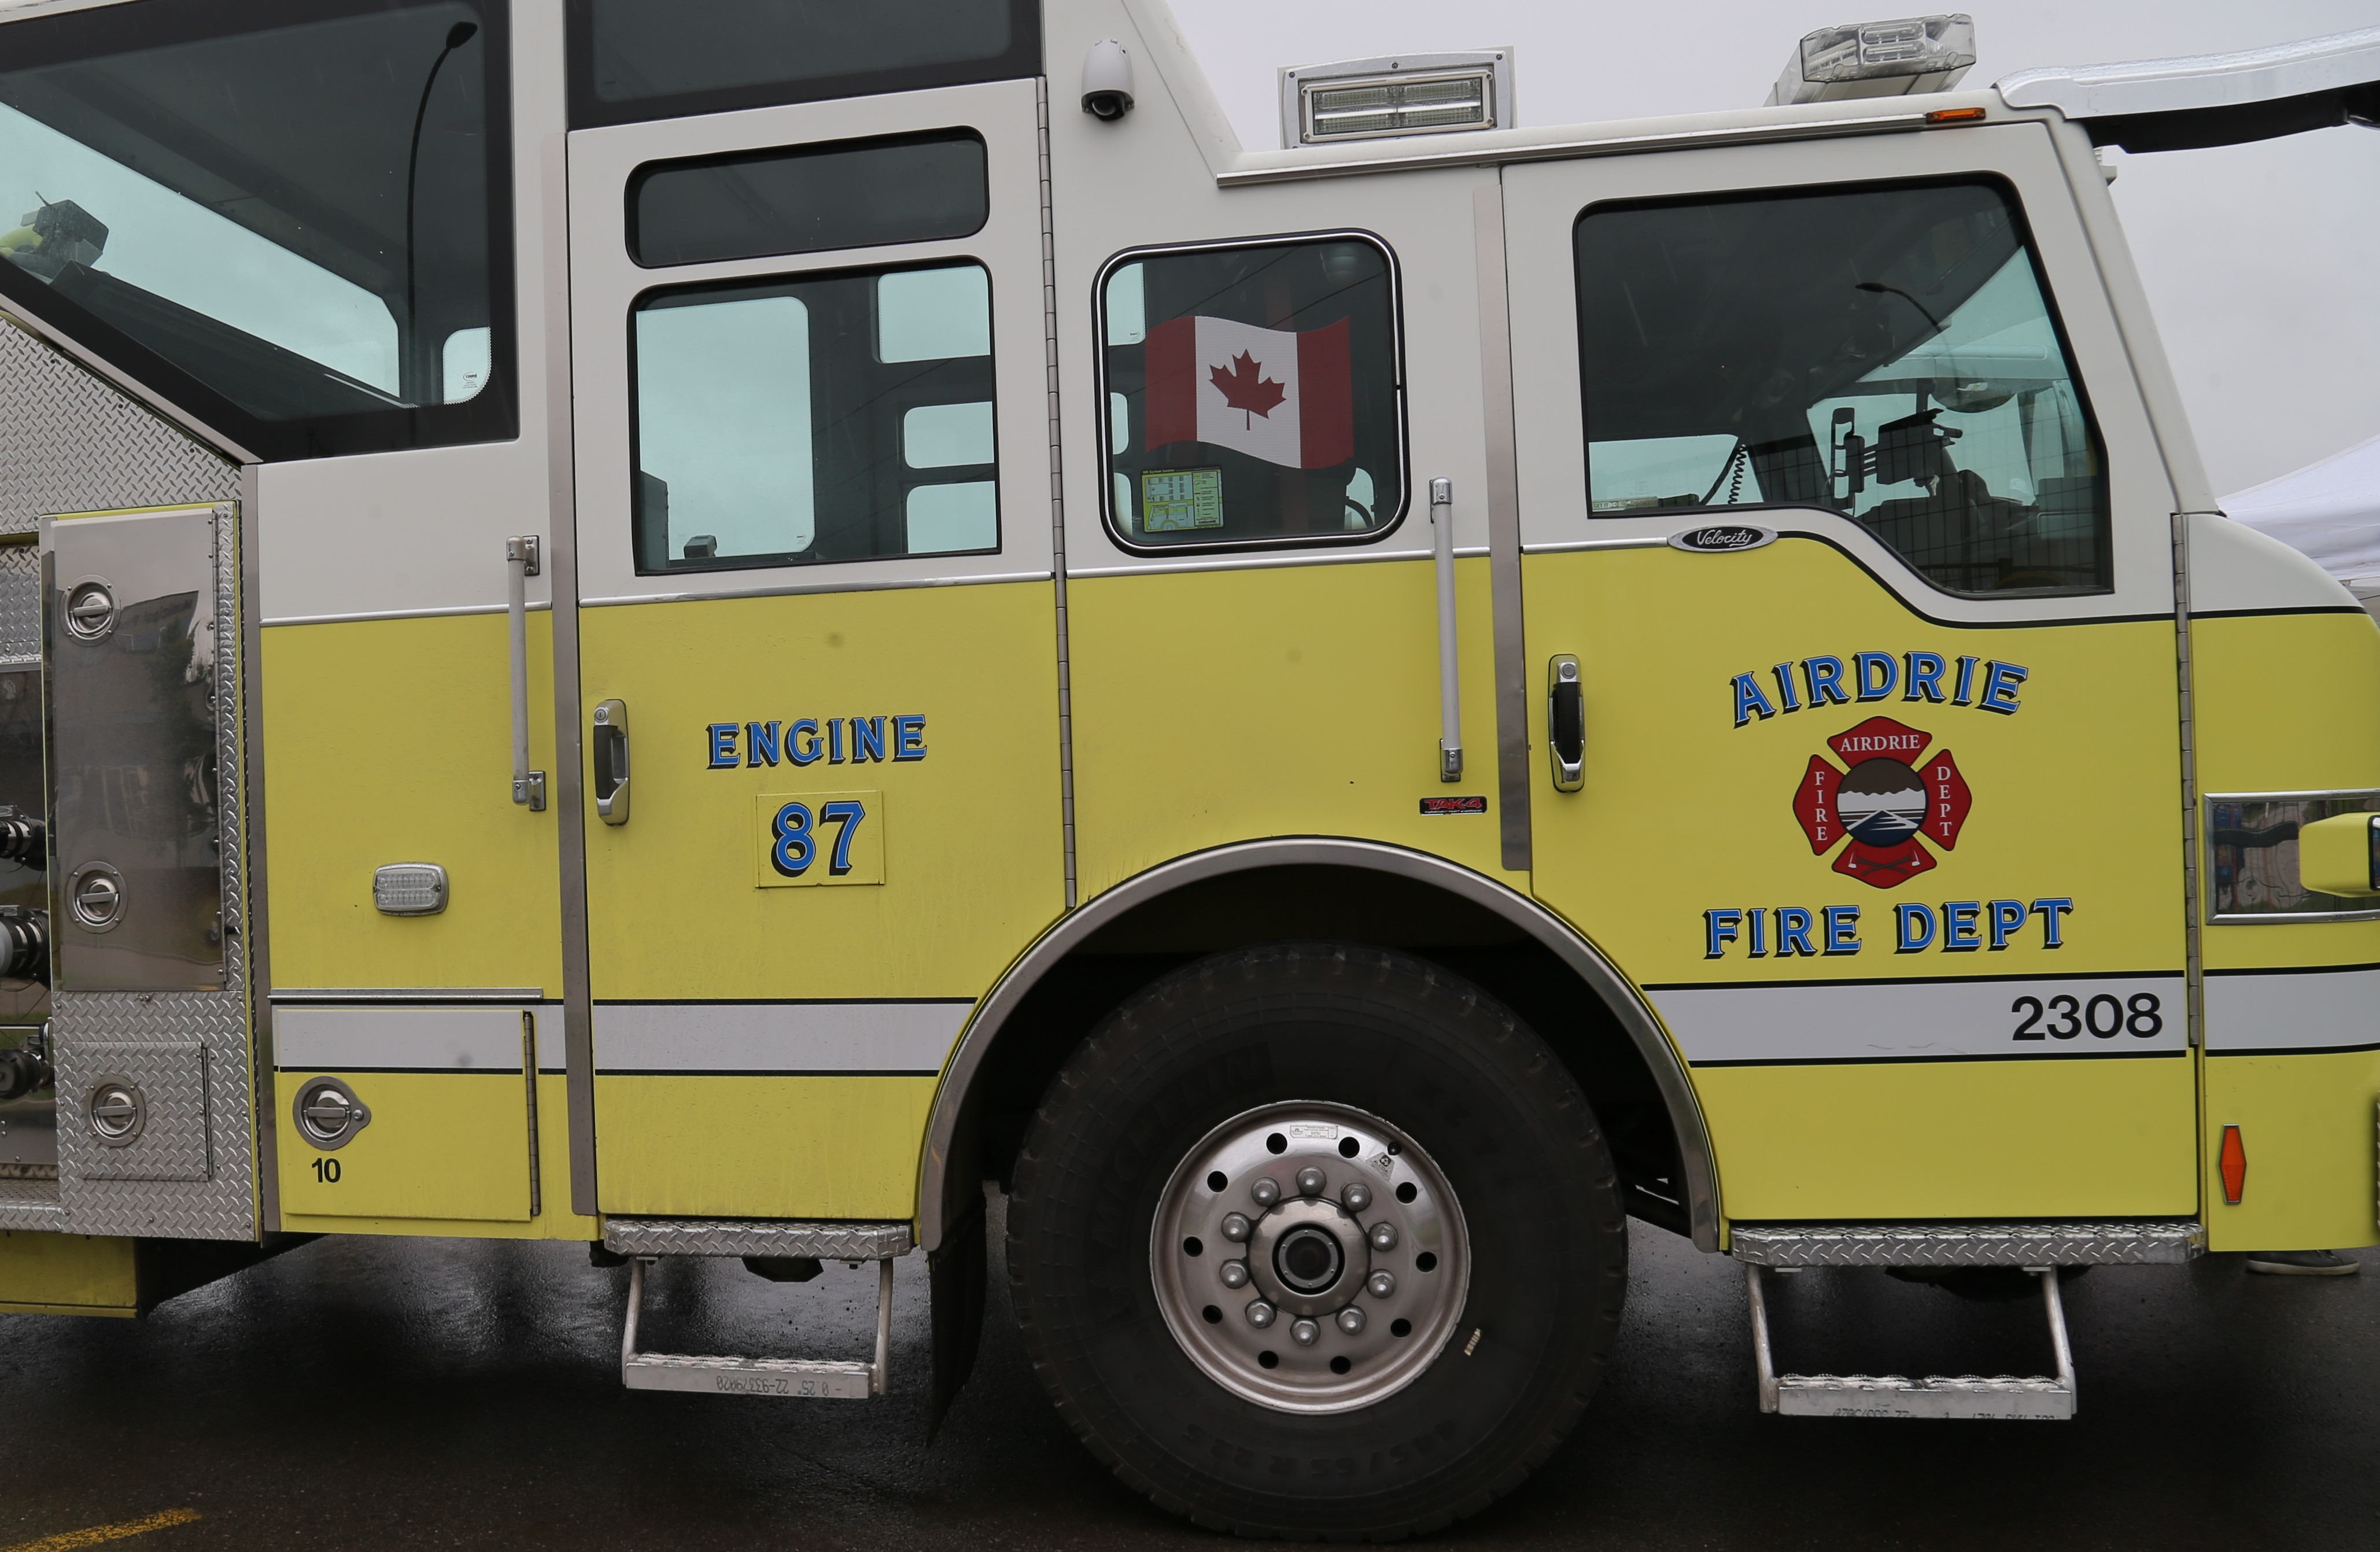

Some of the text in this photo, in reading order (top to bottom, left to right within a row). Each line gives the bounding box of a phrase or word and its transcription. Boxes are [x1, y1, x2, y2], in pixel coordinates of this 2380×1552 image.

[1697, 529, 1752, 547] Velocity
[1729, 651, 2028, 729] AIRDRIE
[706, 714, 927, 769] ENGINE
[1840, 734, 1920, 752] AIRDRIE
[1424, 798, 1482, 810] TAK-4
[1814, 771, 1828, 840] FIRE
[1936, 766, 1953, 836] DEPT
[770, 800, 865, 877] 87
[1702, 897, 2073, 960] FIRE DEPT
[2011, 993, 2163, 1041] 2308
[312, 1157, 341, 1183] 10
